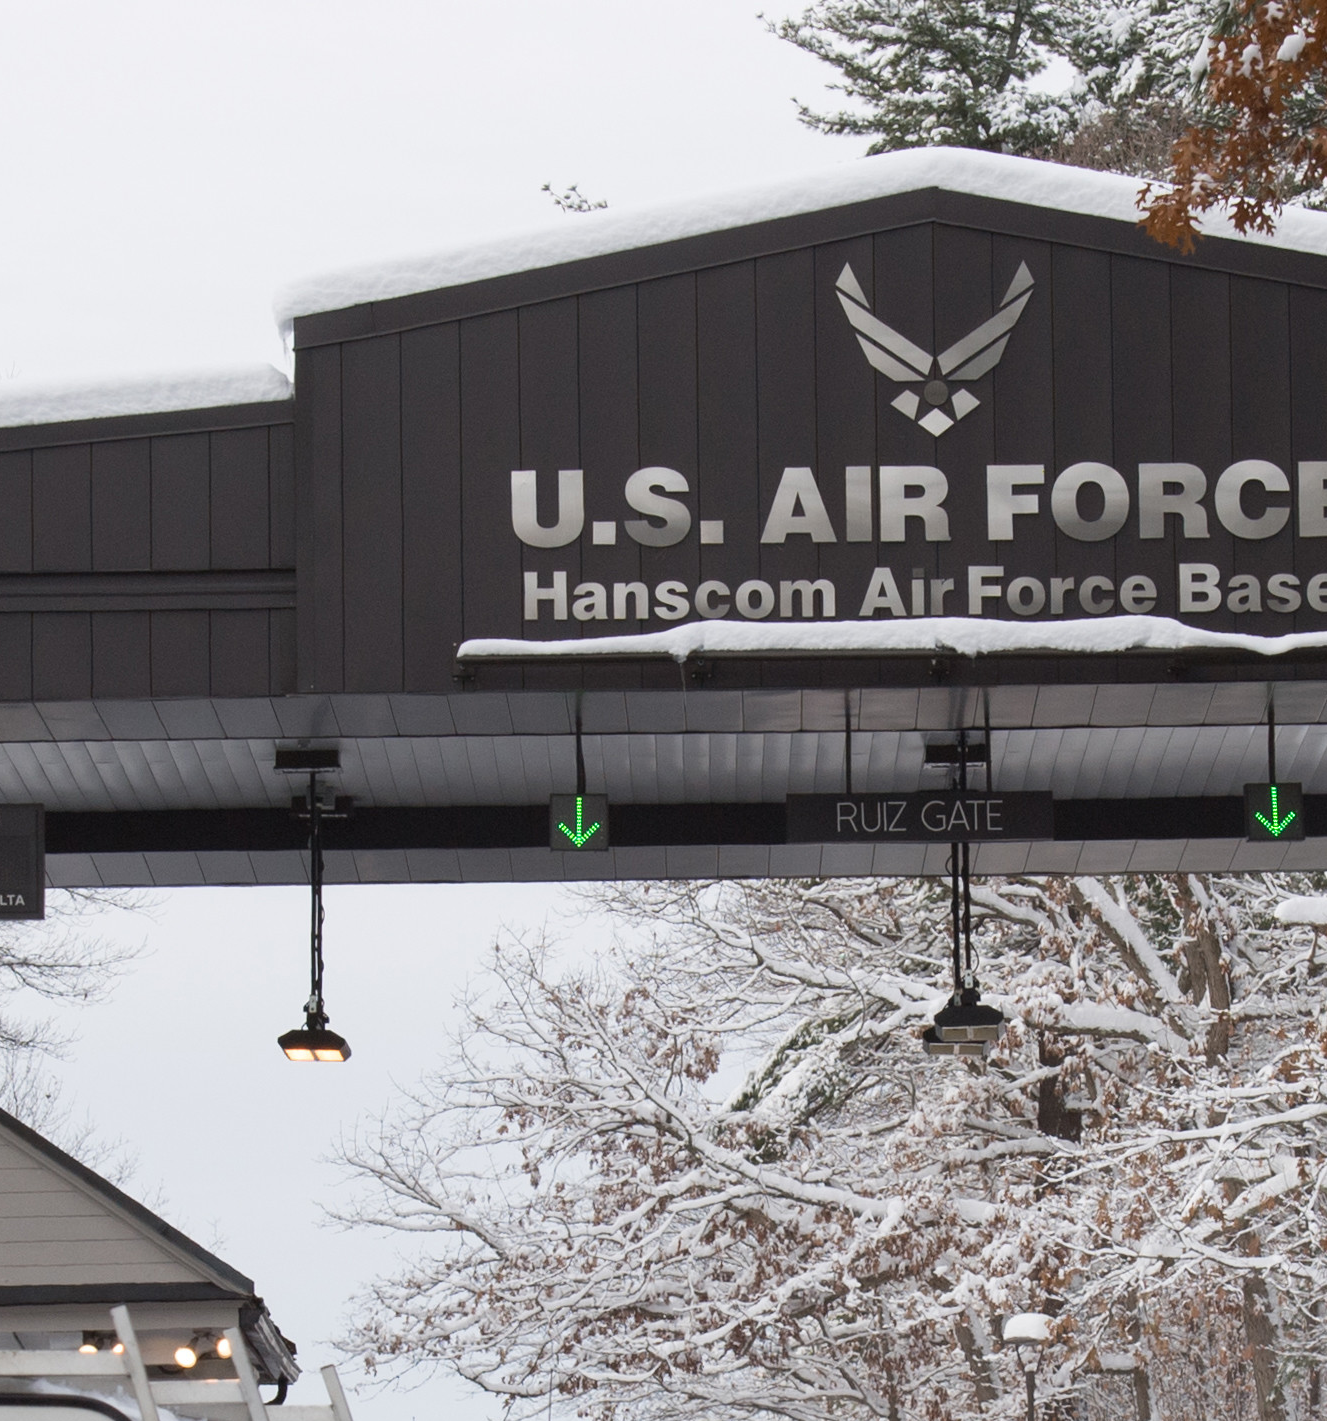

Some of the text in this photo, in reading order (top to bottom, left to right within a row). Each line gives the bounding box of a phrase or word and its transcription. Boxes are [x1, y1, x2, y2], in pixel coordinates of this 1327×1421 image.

[510, 466, 724, 548] U.S.
[760, 465, 951, 544] AIR
[522, 570, 836, 621] Hanscom
[859, 566, 955, 616] Air
[969, 563, 1157, 615] Force
[836, 800, 1003, 832] RUIZ GATE
